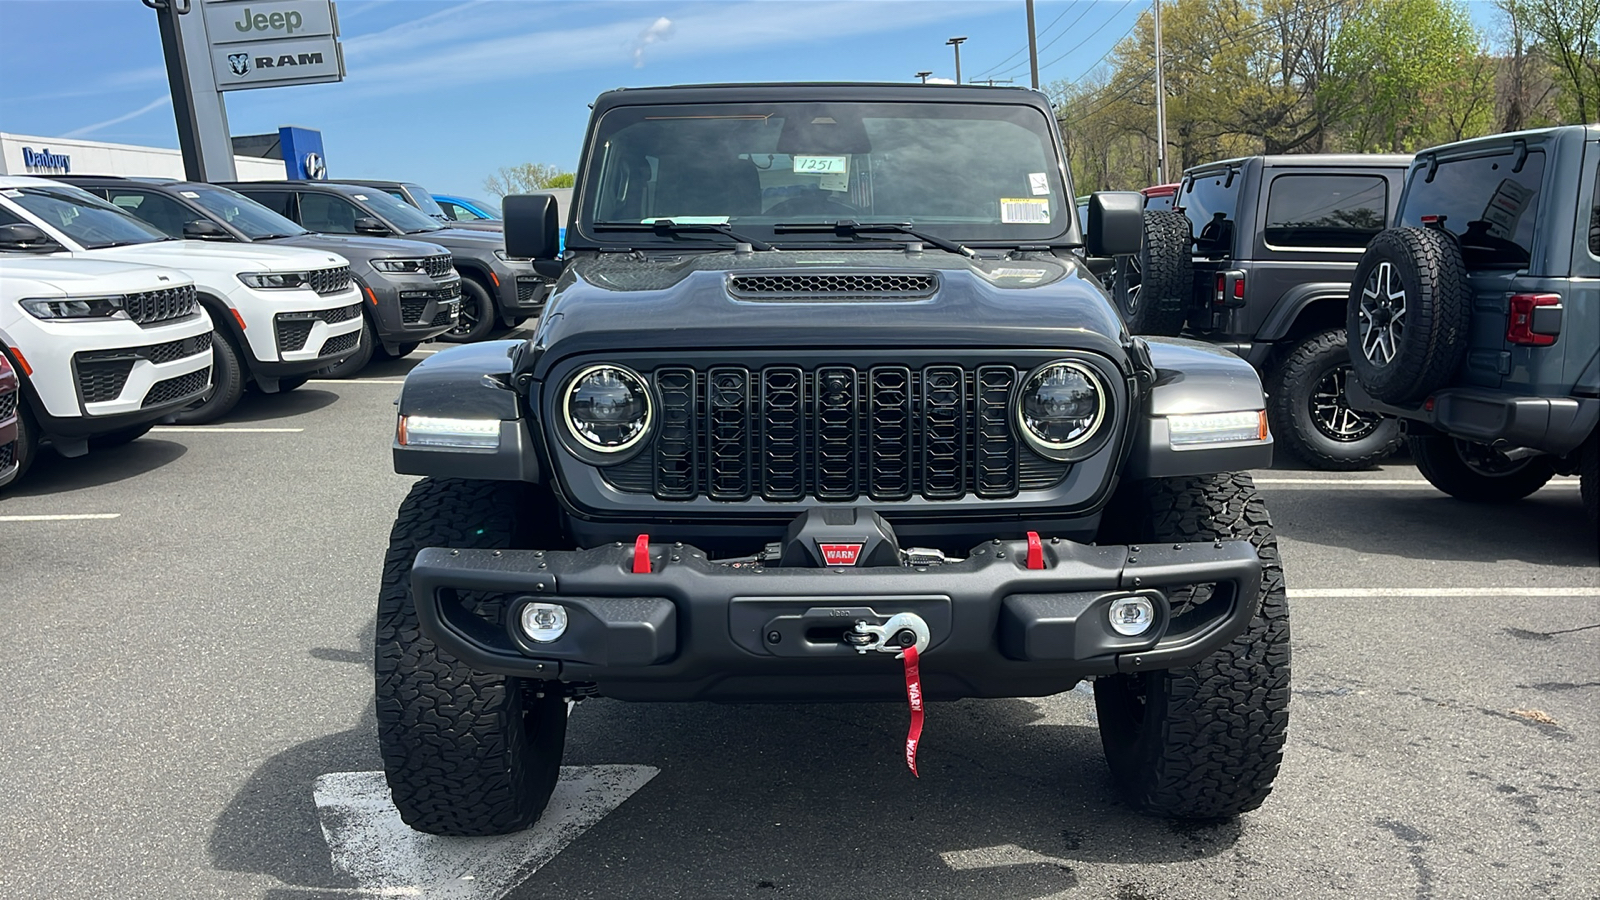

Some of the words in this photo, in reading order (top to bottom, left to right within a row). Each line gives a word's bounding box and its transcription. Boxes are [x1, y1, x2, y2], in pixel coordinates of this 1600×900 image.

[234, 8, 303, 34] Jeep
[254, 52, 324, 69] RAM
[22, 146, 71, 174] Danbury
[800, 158, 833, 171] 1251
[826, 550, 855, 559] WARN
[908, 682, 922, 712] WARN
[906, 739, 917, 771] WARN
